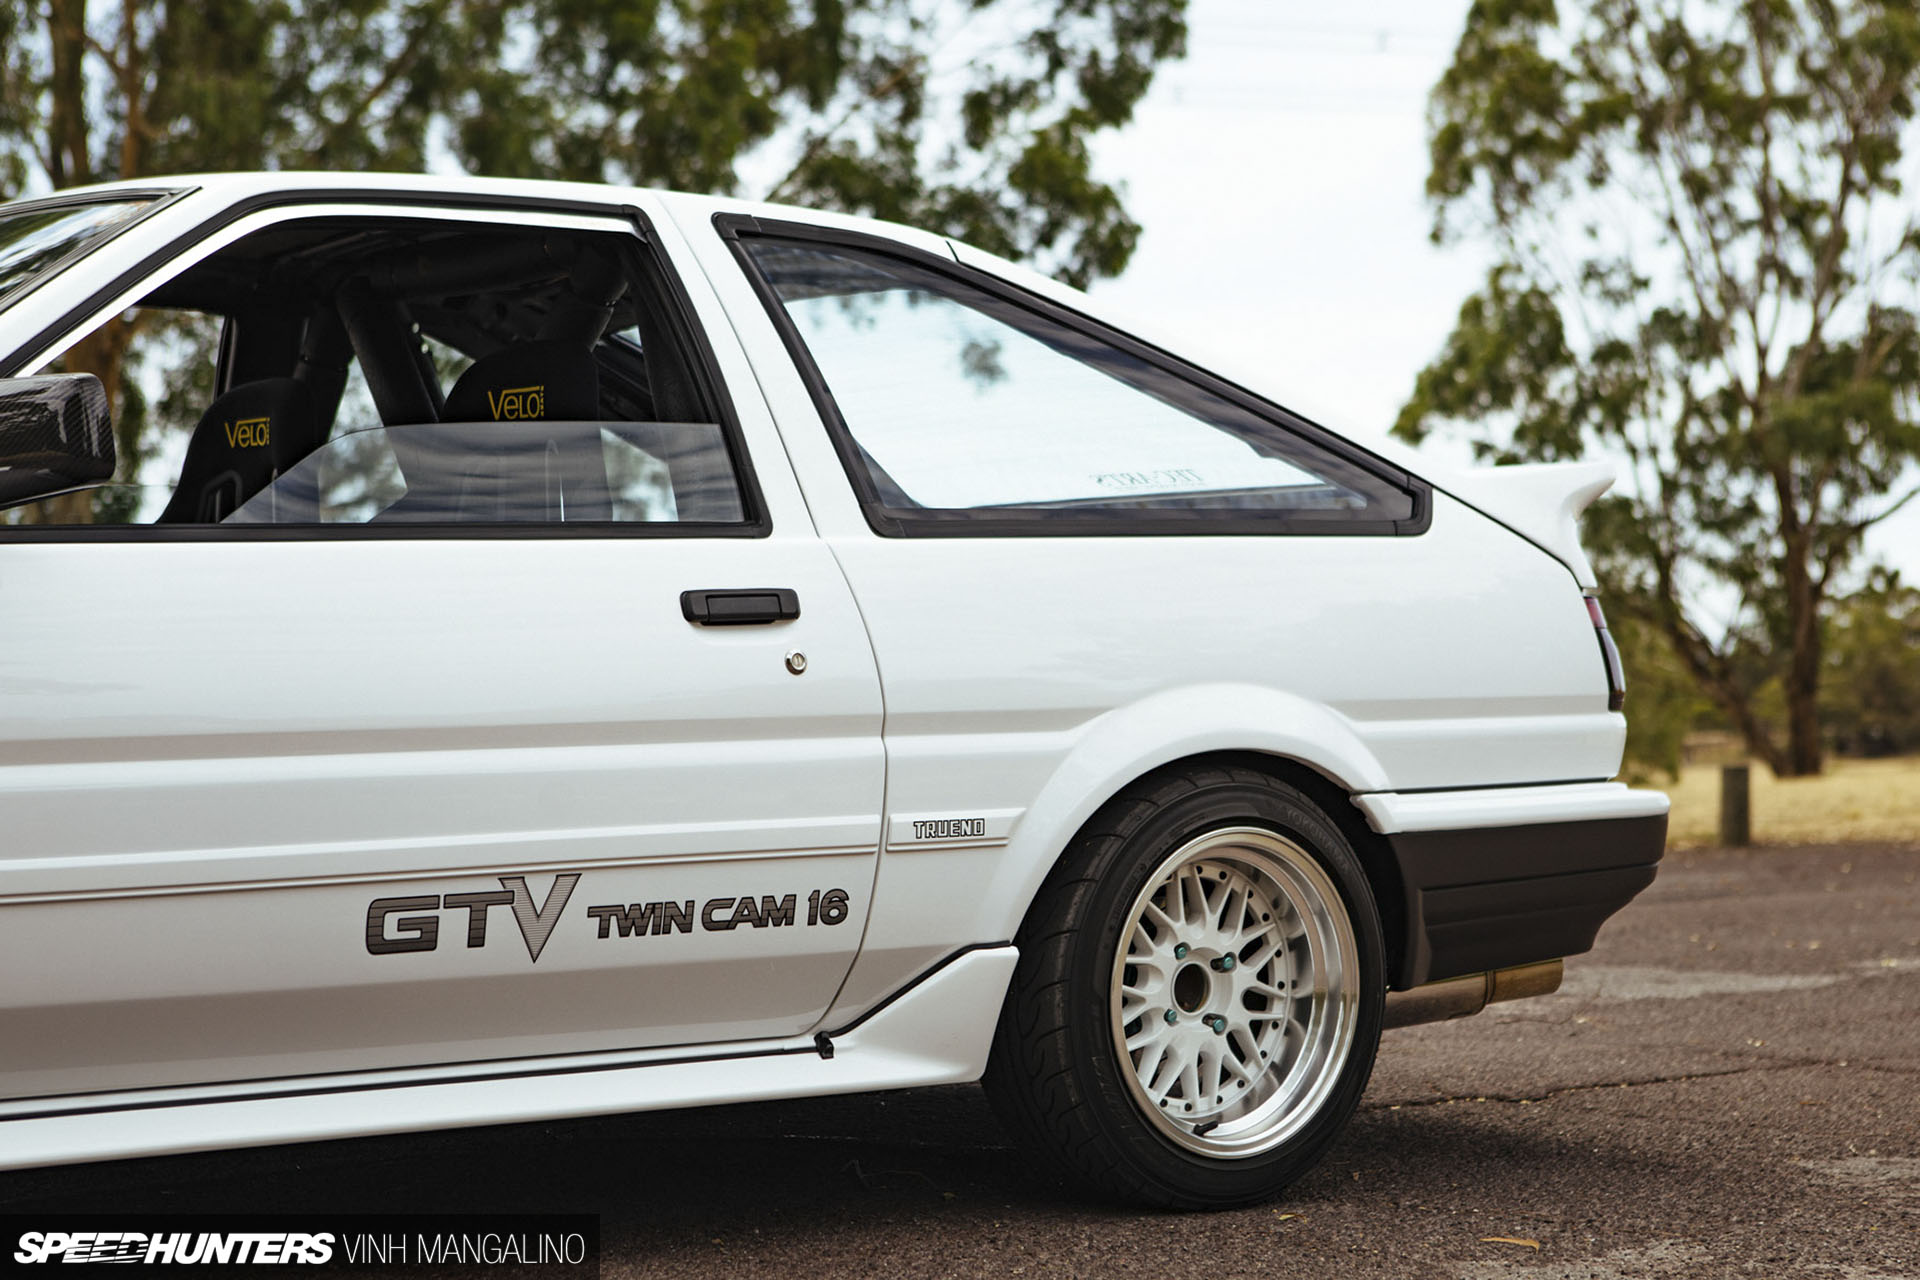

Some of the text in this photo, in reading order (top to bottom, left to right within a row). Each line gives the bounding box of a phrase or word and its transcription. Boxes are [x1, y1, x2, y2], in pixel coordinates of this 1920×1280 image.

[913, 818, 985, 839] TRUENO
[587, 900, 695, 939] TWIN
[701, 894, 797, 931] CAM
[807, 888, 850, 927] 16
